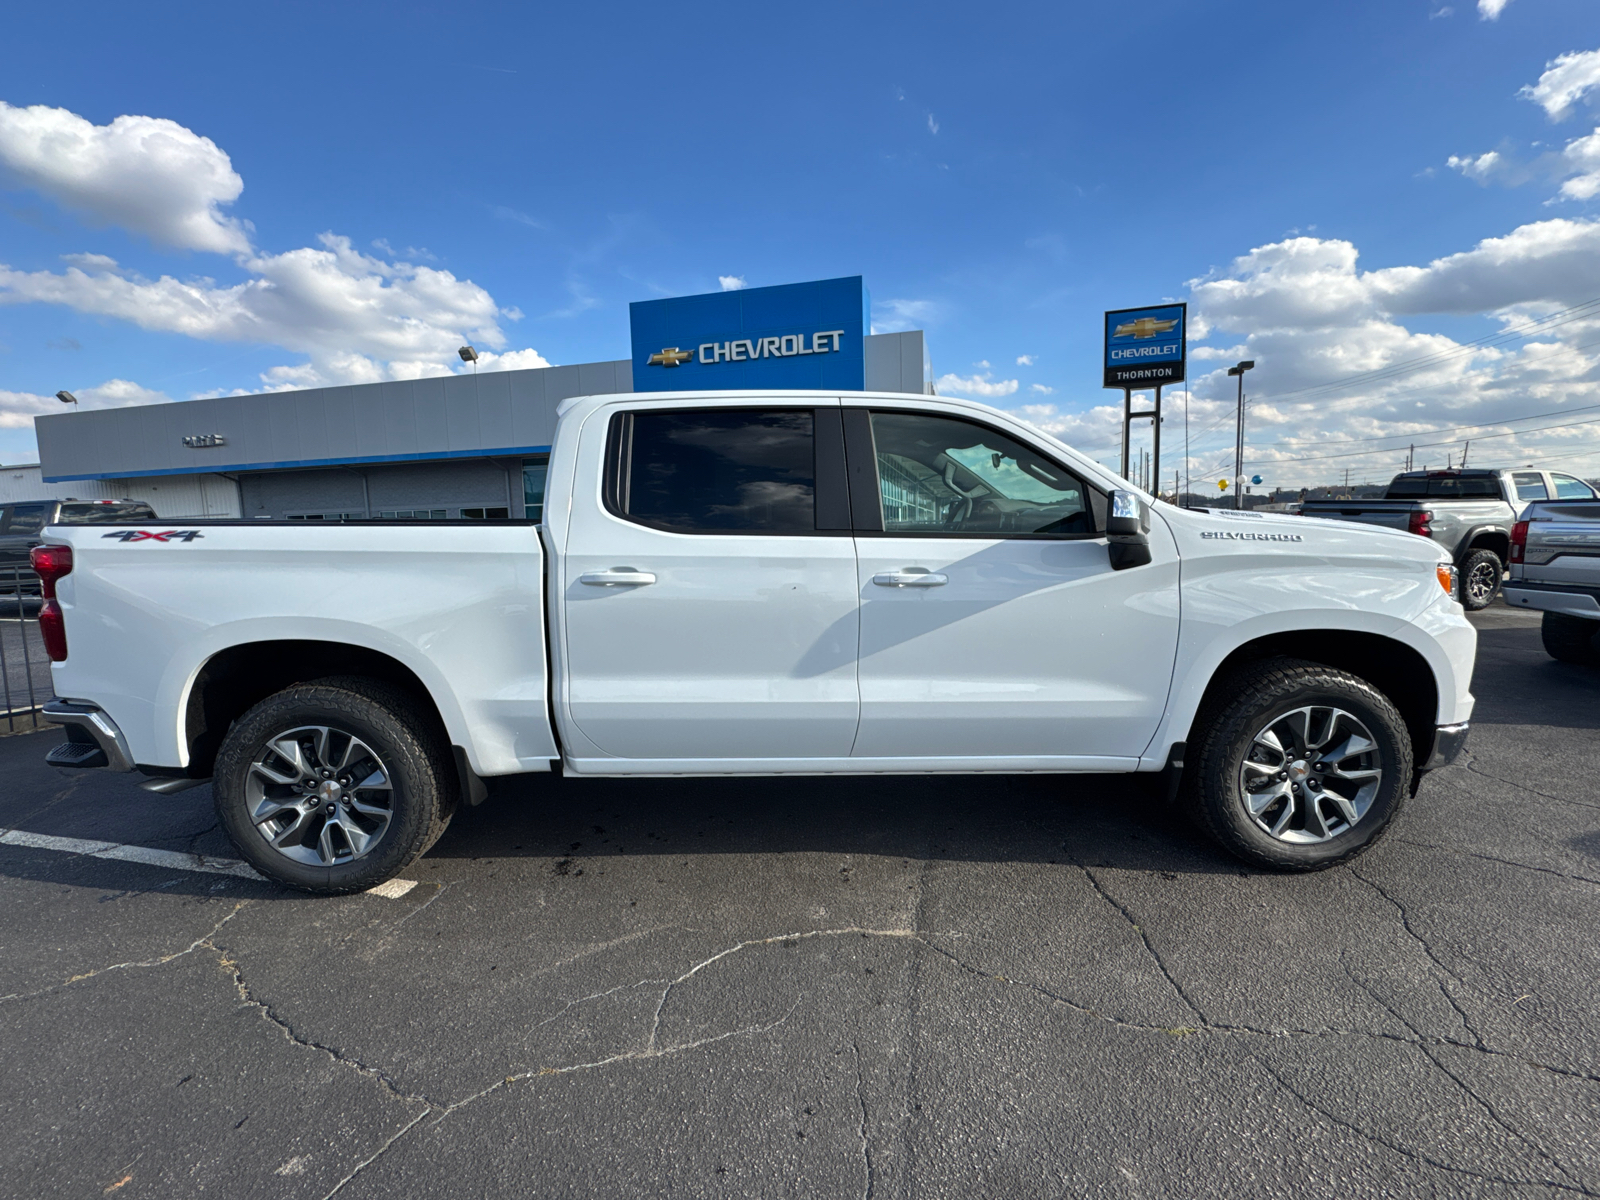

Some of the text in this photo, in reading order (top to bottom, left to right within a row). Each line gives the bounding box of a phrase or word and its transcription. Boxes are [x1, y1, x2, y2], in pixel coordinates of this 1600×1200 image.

[699, 330, 844, 364] CHEVROLET
[1111, 344, 1178, 359] CHEVROLET
[1116, 368, 1172, 380] THORNTON
[1200, 531, 1303, 542] SILVERADO
